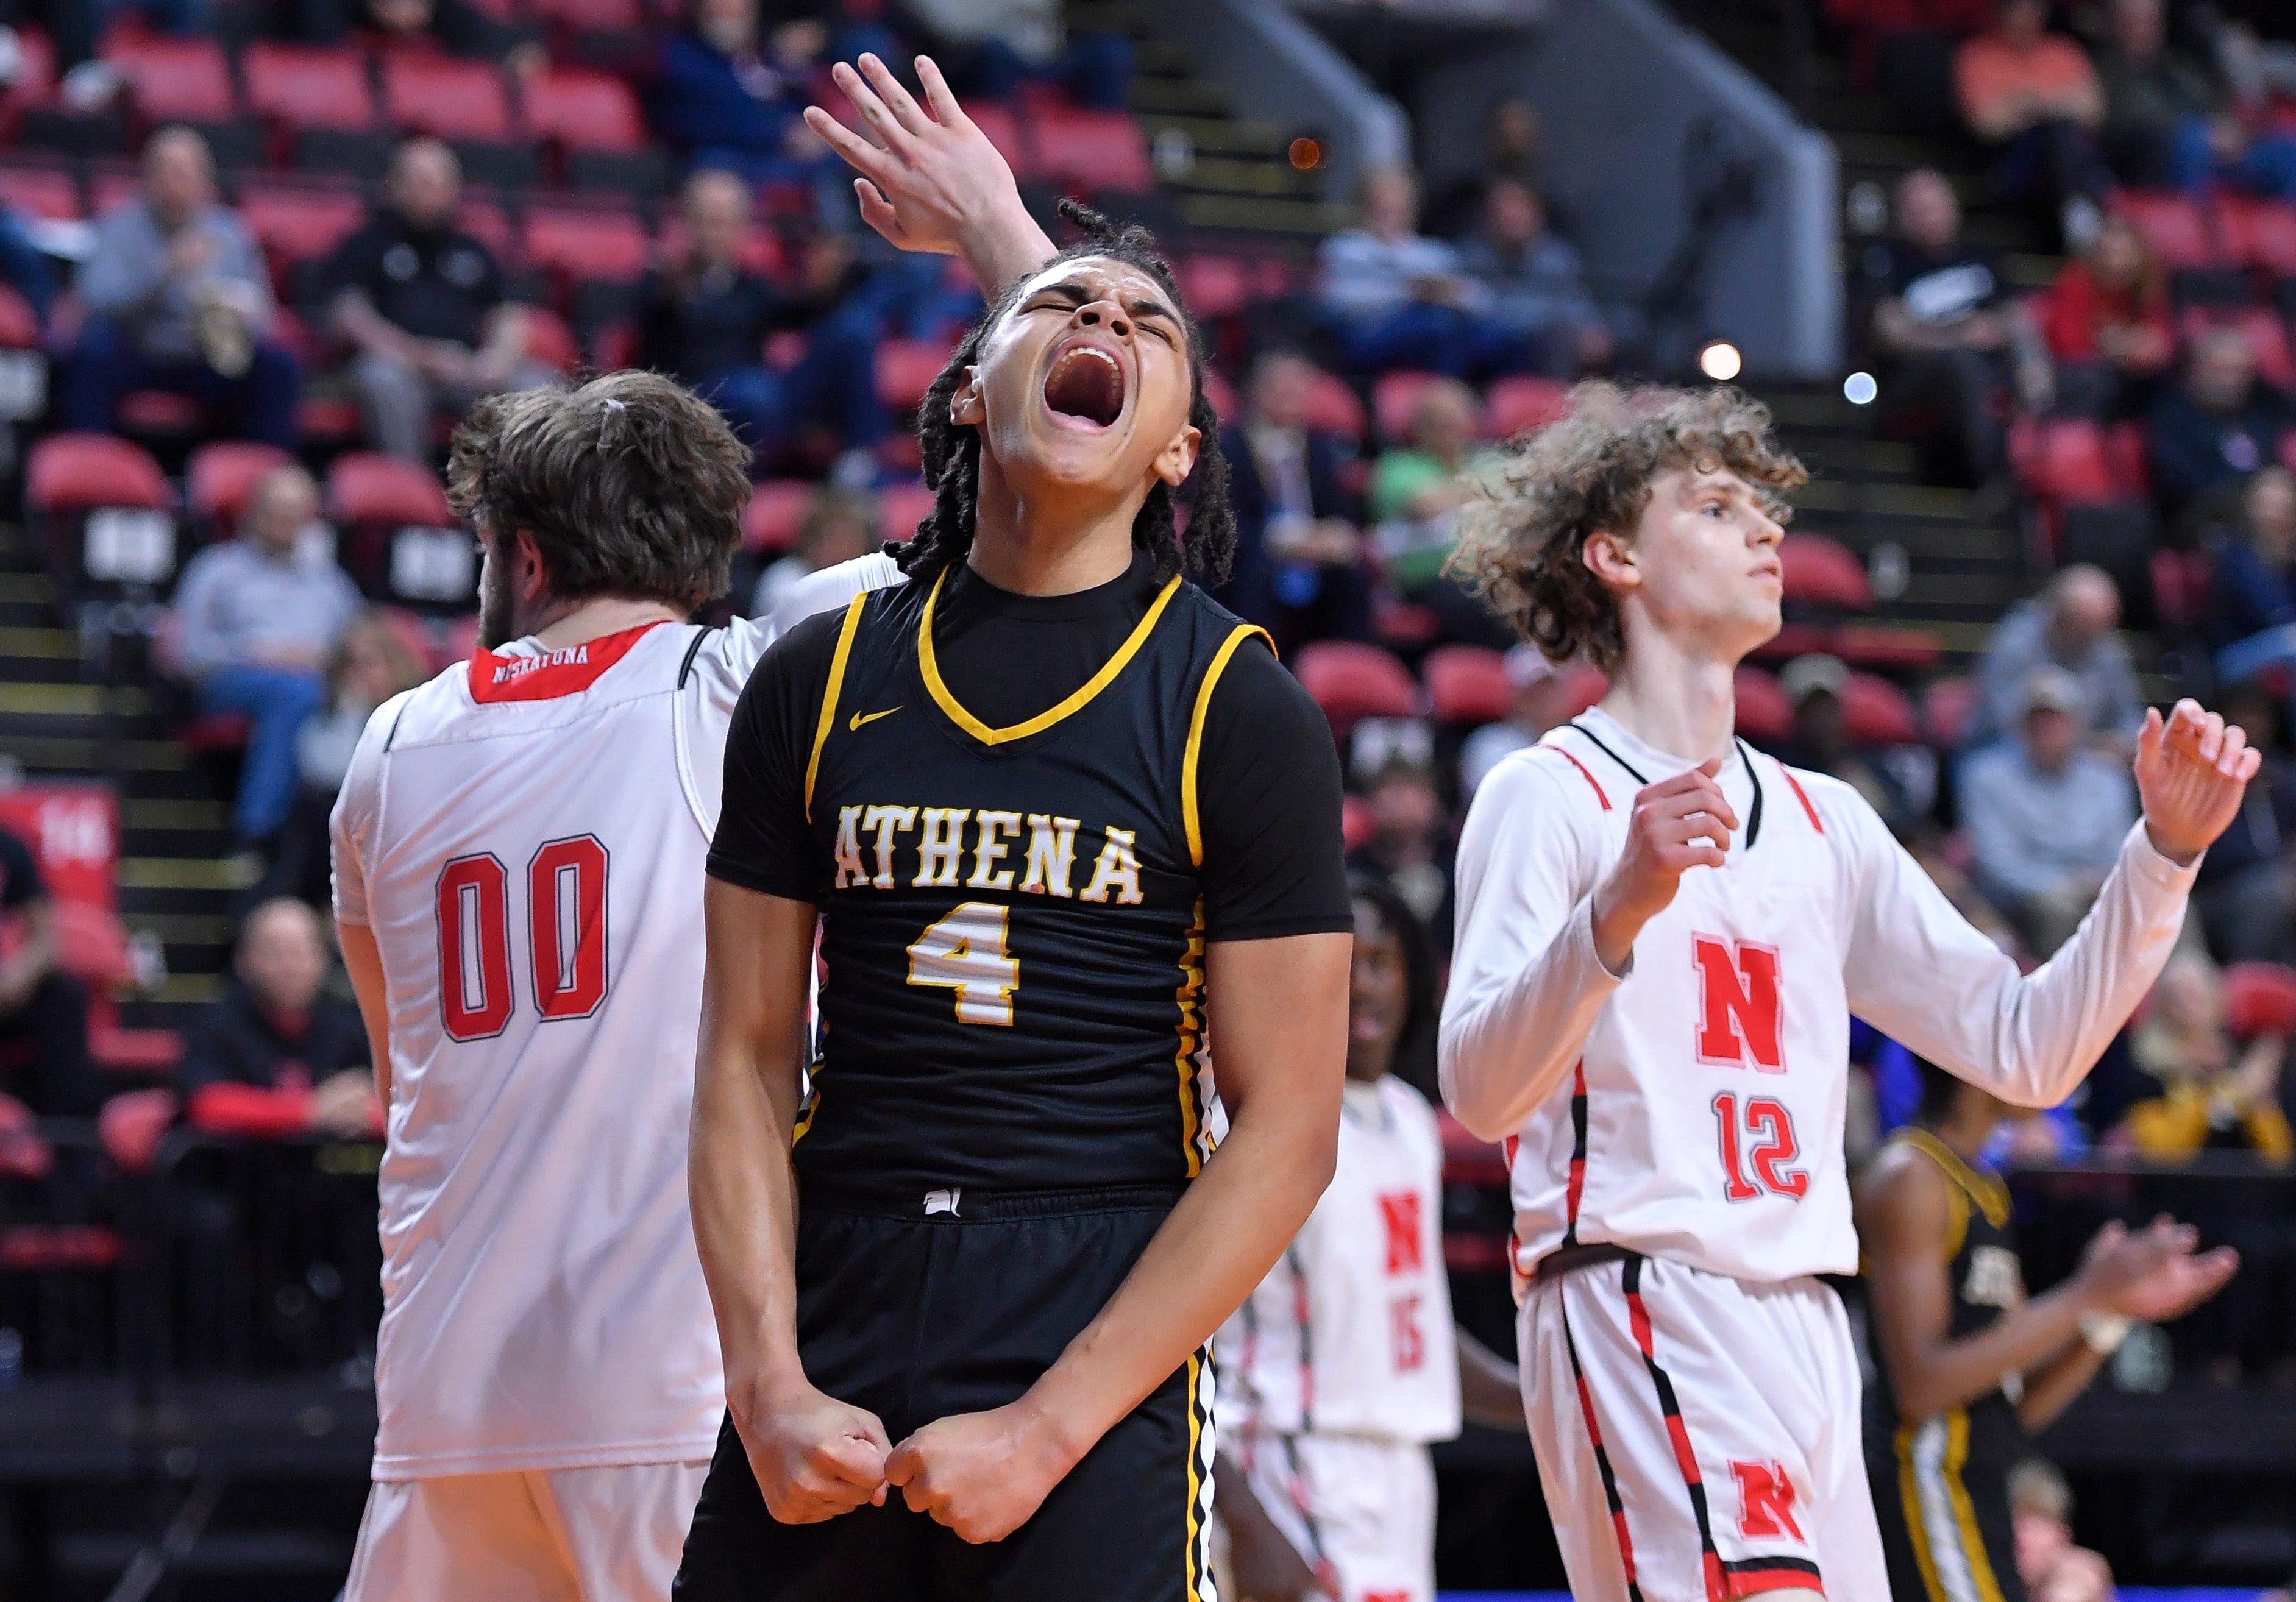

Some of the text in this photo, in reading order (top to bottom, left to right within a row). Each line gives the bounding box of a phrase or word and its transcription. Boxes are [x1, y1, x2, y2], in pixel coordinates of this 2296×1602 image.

[834, 804, 1145, 904] ATHENA
[435, 832, 610, 1044] 00
[906, 902, 1020, 1027] 4
[1691, 930, 1787, 1074] N
[1711, 1090, 1809, 1205] 12
[1377, 1190, 1423, 1274] N
[1389, 1295, 1424, 1372] 15
[1727, 1459, 1808, 1548] N
